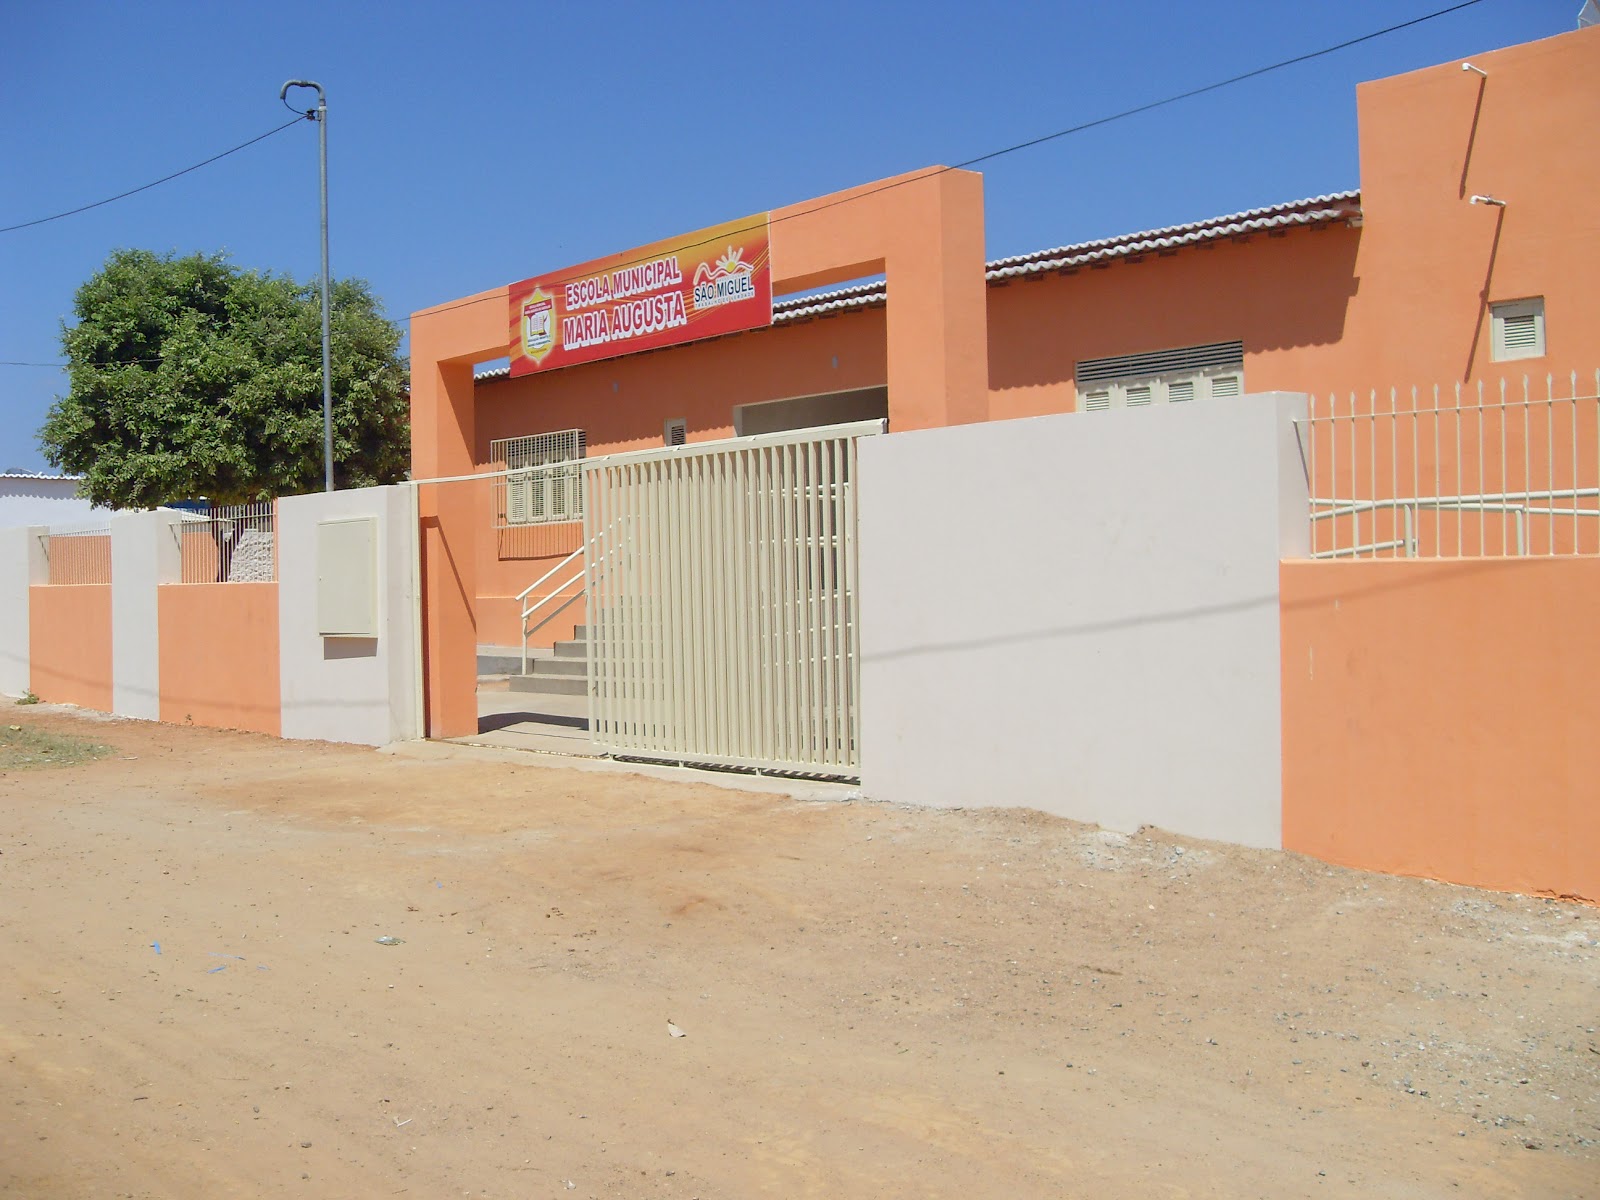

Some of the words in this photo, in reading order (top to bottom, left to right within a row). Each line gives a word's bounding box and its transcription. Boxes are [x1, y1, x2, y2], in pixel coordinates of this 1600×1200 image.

[565, 276, 611, 310] ESCOLA
[612, 256, 682, 298] MUNICIPAL
[694, 282, 715, 303] SÃO
[717, 276, 754, 298] MIGUEL
[563, 309, 611, 350] MARIA
[611, 291, 687, 340] AUGUSTA
